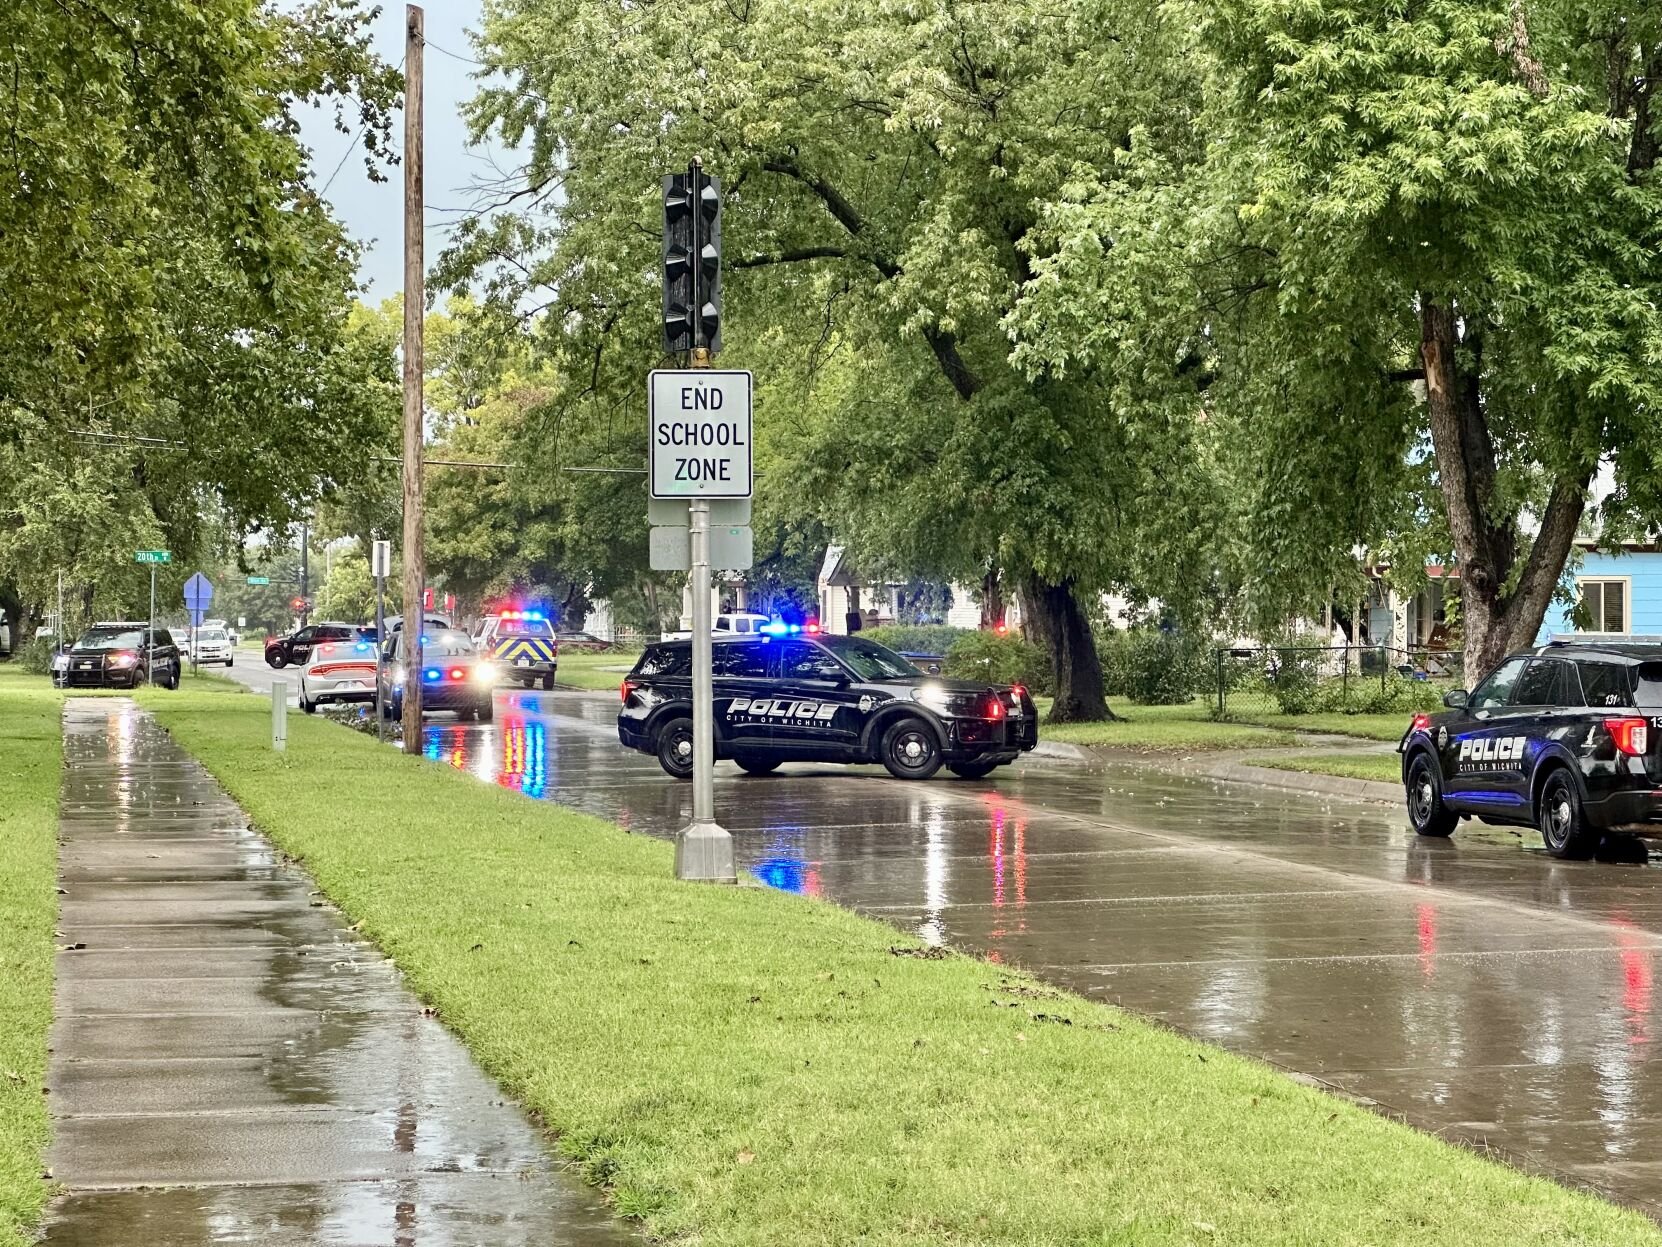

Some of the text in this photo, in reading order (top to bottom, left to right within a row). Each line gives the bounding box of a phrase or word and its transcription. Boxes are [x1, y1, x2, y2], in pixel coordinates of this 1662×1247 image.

[681, 387, 723, 410] END
[658, 422, 745, 446] SCHOOL
[674, 458, 731, 481] ZONE
[137, 552, 154, 561] 20th
[727, 698, 840, 720] POLICE
[1605, 694, 1618, 706] 131
[726, 714, 752, 722] CITY
[782, 718, 832, 728] WICHITA
[1459, 736, 1527, 762] POLICE
[1459, 762, 1522, 772] CITY OF WICHITA
